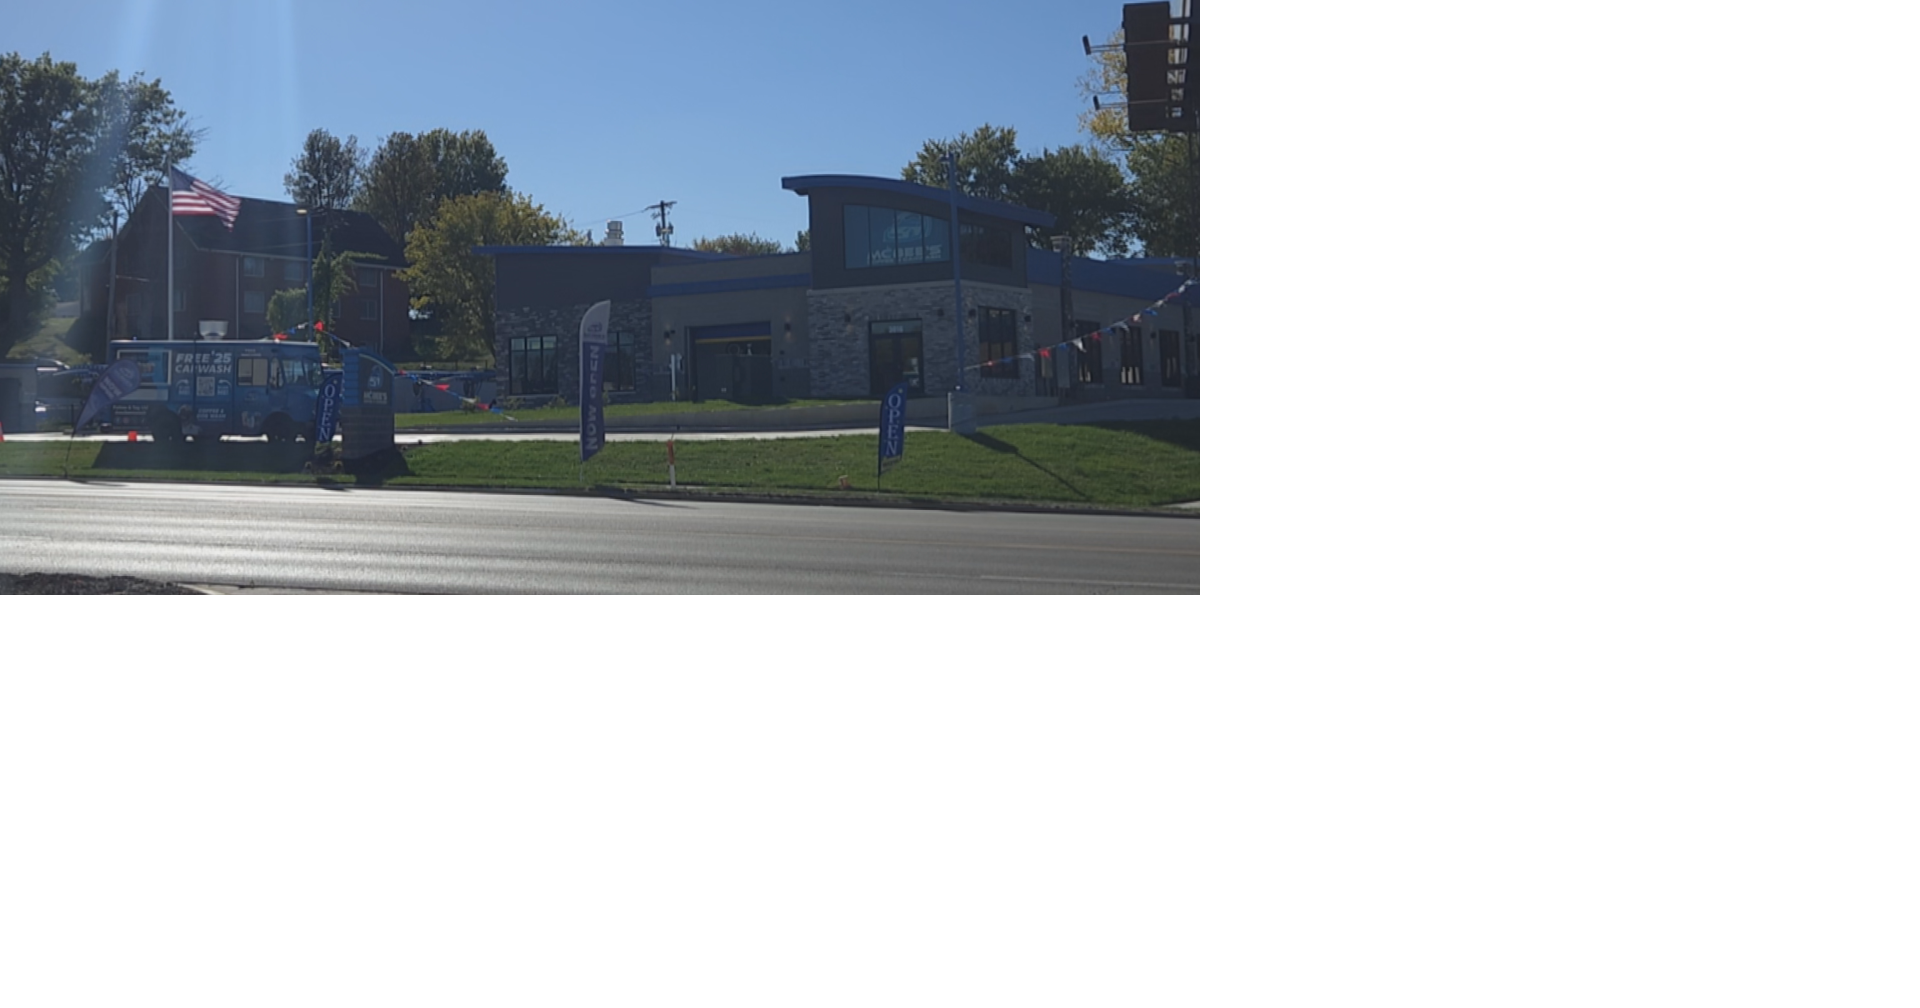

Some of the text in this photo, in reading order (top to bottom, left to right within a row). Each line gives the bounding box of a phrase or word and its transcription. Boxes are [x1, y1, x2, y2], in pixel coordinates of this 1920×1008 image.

[176, 353, 210, 364] FREE
[319, 384, 336, 441] OPEN
[586, 405, 598, 450] NOW
[886, 393, 902, 456] OPEN
